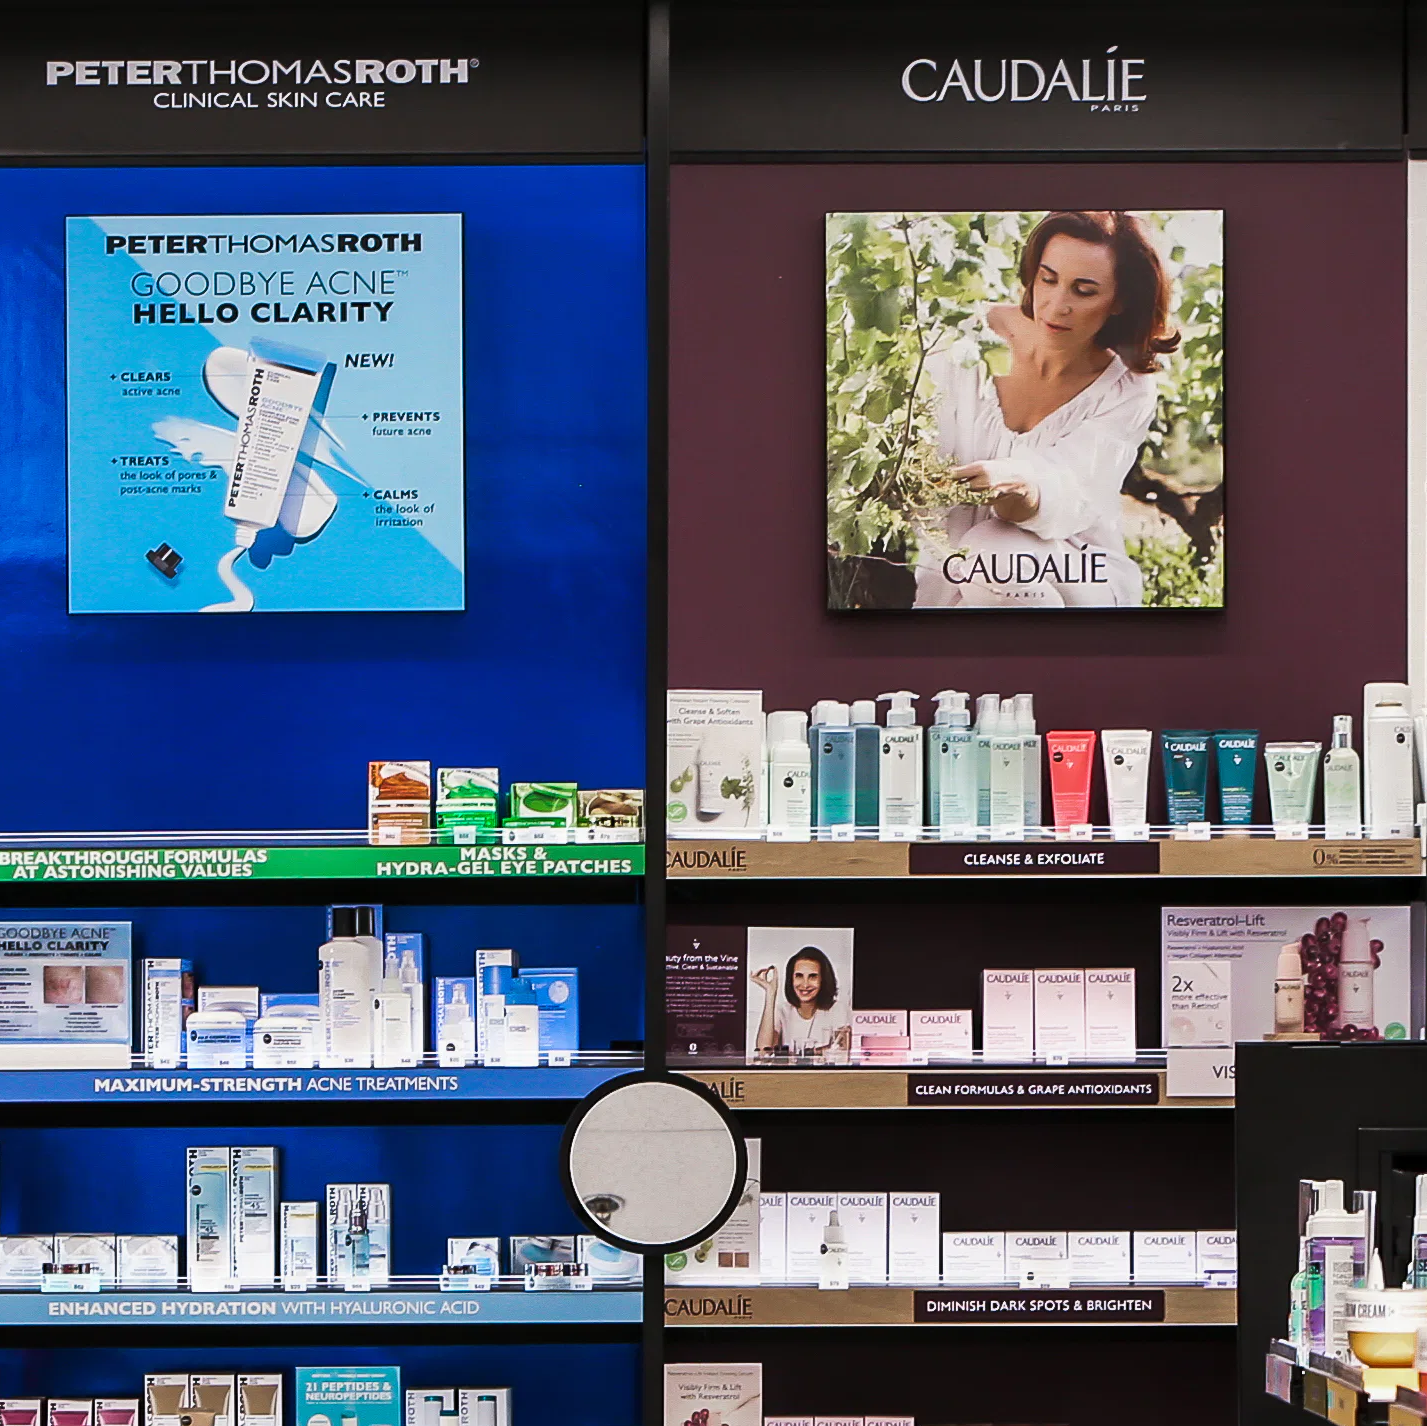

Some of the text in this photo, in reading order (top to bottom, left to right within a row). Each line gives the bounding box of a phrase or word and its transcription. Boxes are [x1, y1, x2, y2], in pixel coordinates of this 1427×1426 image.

[902, 45, 1147, 101] CAUDALÍE
[153, 92, 385, 109] CLINICAL SKIN CARE
[1090, 104, 1139, 112] PARIS
[106, 233, 422, 254] PETERTHOMASROTH
[131, 271, 295, 296] GOODBYE
[133, 301, 394, 324] HELLO CLARITY
[345, 353, 395, 368] NEW!
[121, 372, 171, 382] CLEARS
[122, 386, 181, 397] active acne
[373, 411, 440, 422] PREVENTS
[372, 426, 432, 437] future acne
[121, 456, 169, 467] TREATS
[120, 469, 217, 483] the look of pores &
[373, 490, 418, 500] CALMS
[375, 503, 435, 514] the look of
[375, 517, 423, 527] irritation
[943, 544, 1108, 585] CAUDALÍE
[164, 849, 267, 864] FORMULAS
[460, 847, 547, 861] MASKS &
[964, 853, 1105, 866] CLEANSE & EXFOLIATE
[12, 864, 252, 879] AT ASTONISHING VALUES
[377, 859, 631, 876] HYDRA-GEL EYE PATCHES
[47, 941, 109, 951] CLARITY
[1172, 976, 1193, 992] 2x
[94, 1076, 458, 1093] MAXIMUM-STRENGTH ACNE TREATMENTS
[915, 1084, 1152, 1095] CLEAN FORMULAS & GRAPE ANTIOXIDANTS
[48, 1301, 479, 1316] ENHANCED HYDRATION WITH HYALURONIC ACID
[927, 1300, 1152, 1312] DIMINISH DARK SPOTS & BRIGHTEN
[1358, 1303, 1386, 1318] CREAM
[306, 1392, 392, 1401] NEUROPEPTIDES
